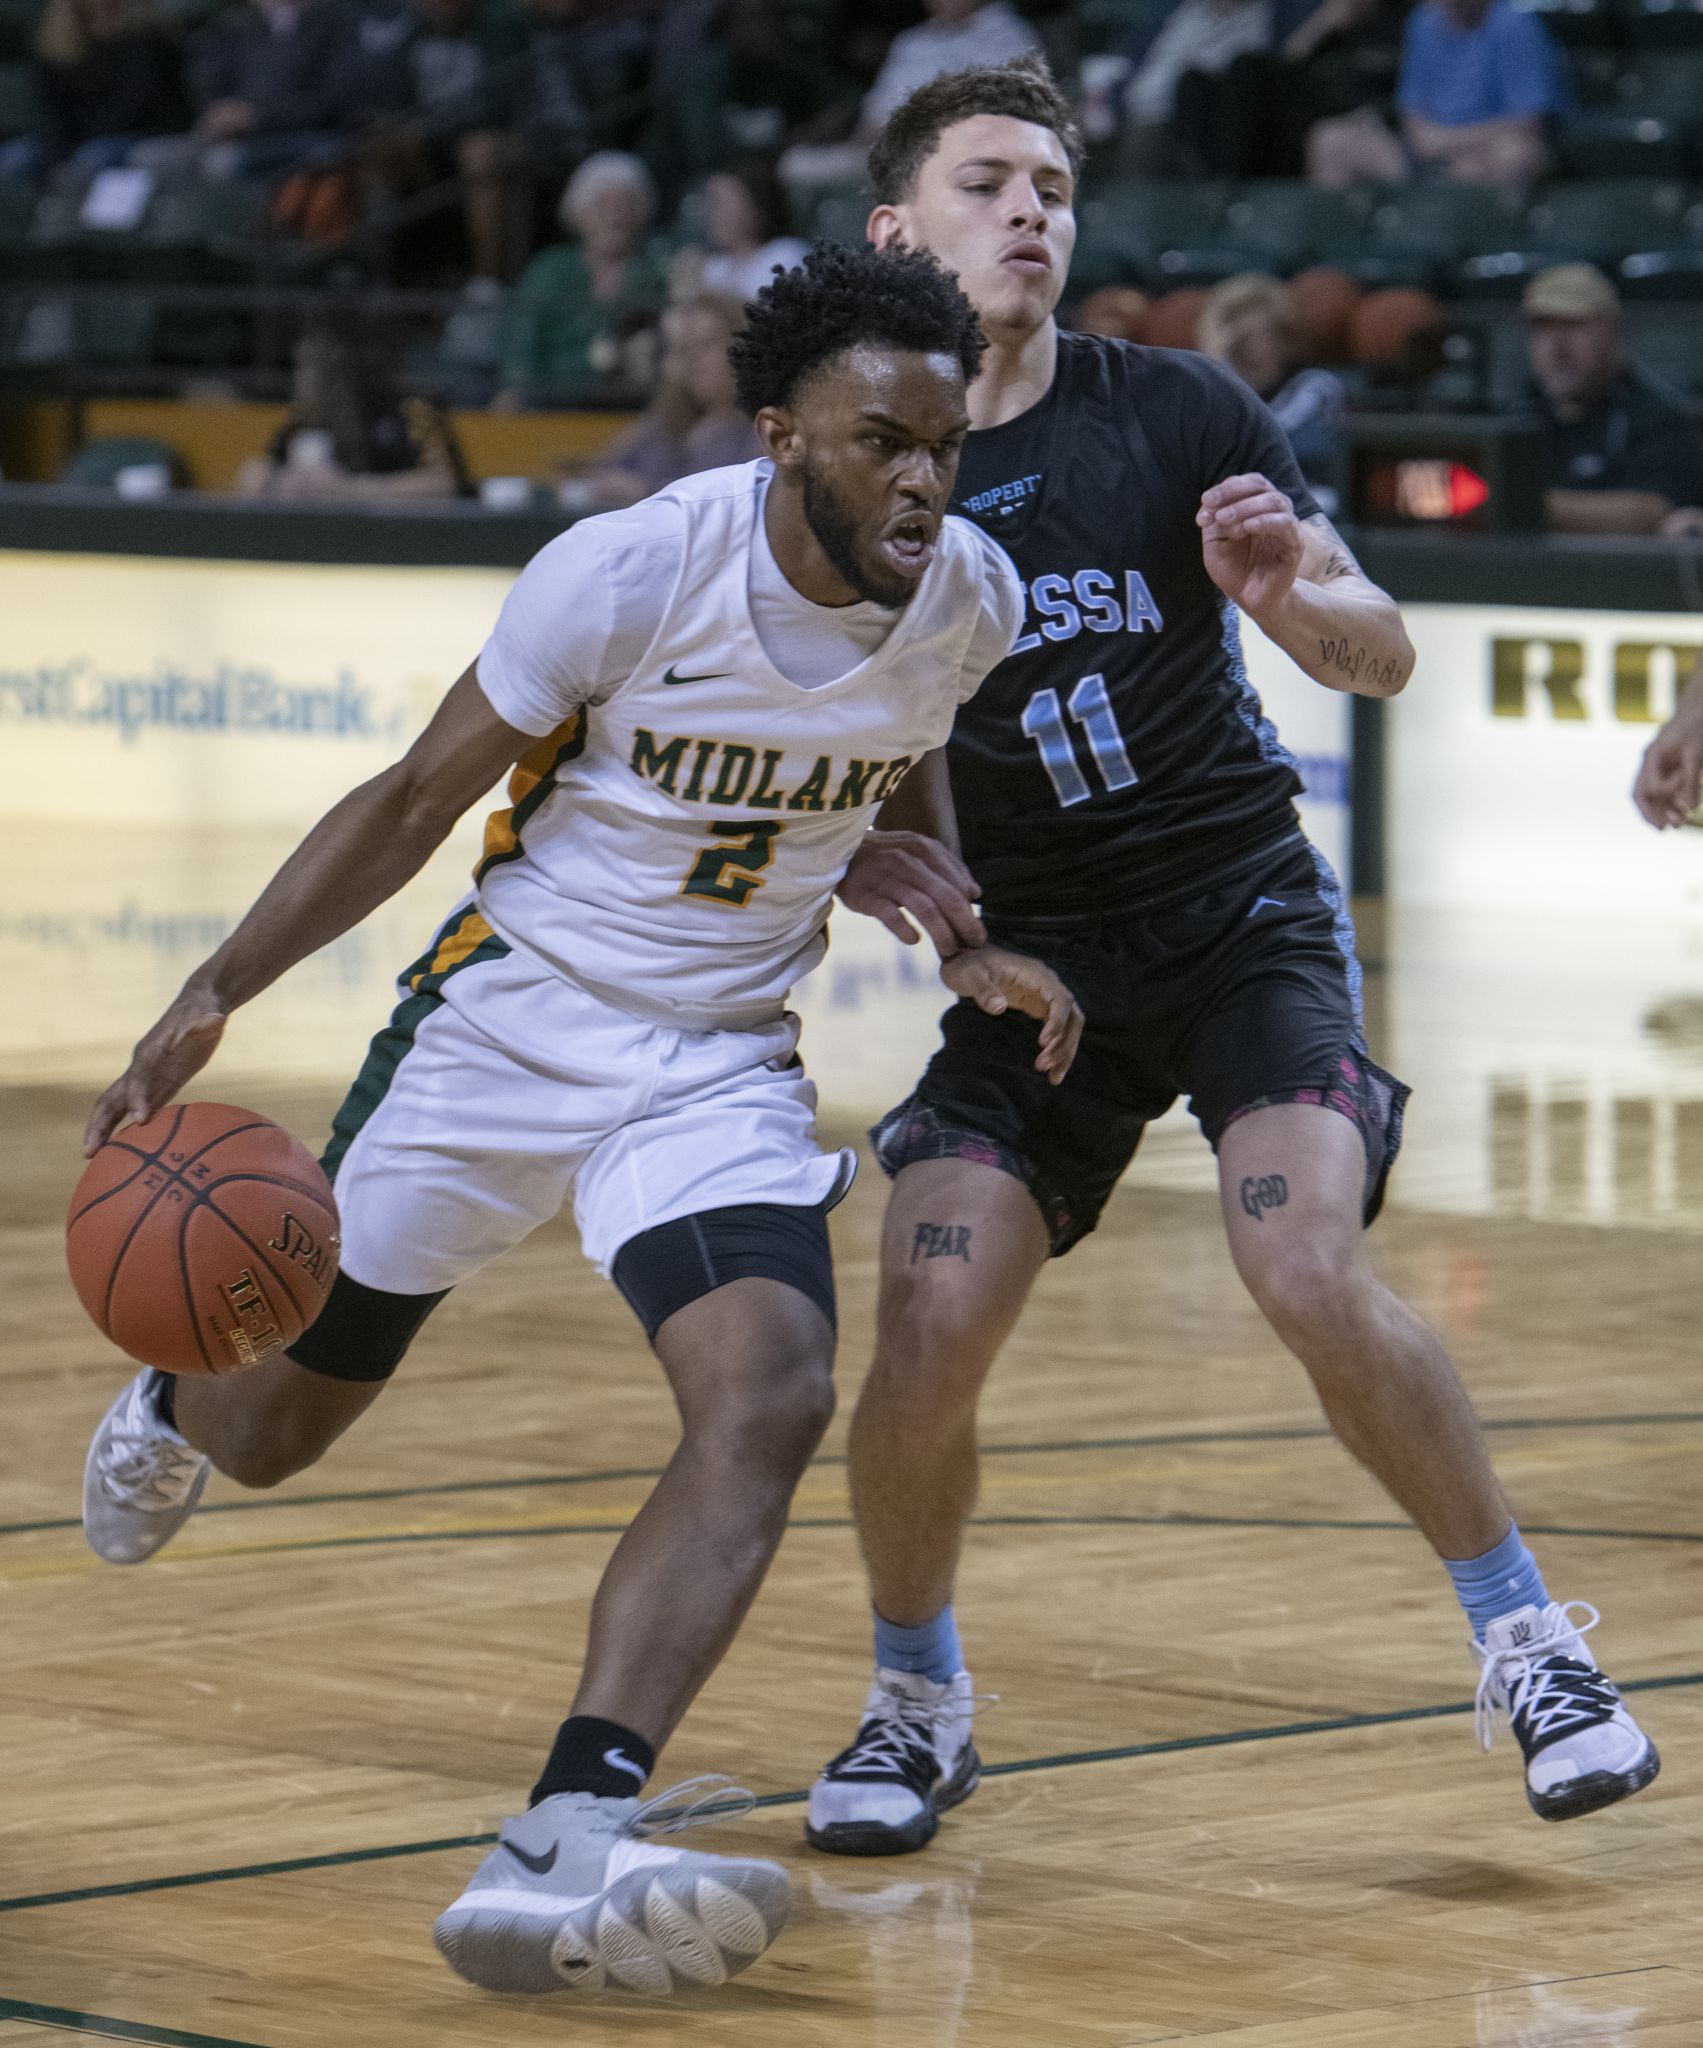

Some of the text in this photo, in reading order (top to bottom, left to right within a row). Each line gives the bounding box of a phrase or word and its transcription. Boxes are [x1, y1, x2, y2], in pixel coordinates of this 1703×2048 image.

[1020, 672, 1139, 808] 11
[678, 820, 786, 909] 2
[1240, 1173, 1289, 1223] GOD
[910, 1222, 973, 1265] FEAR
